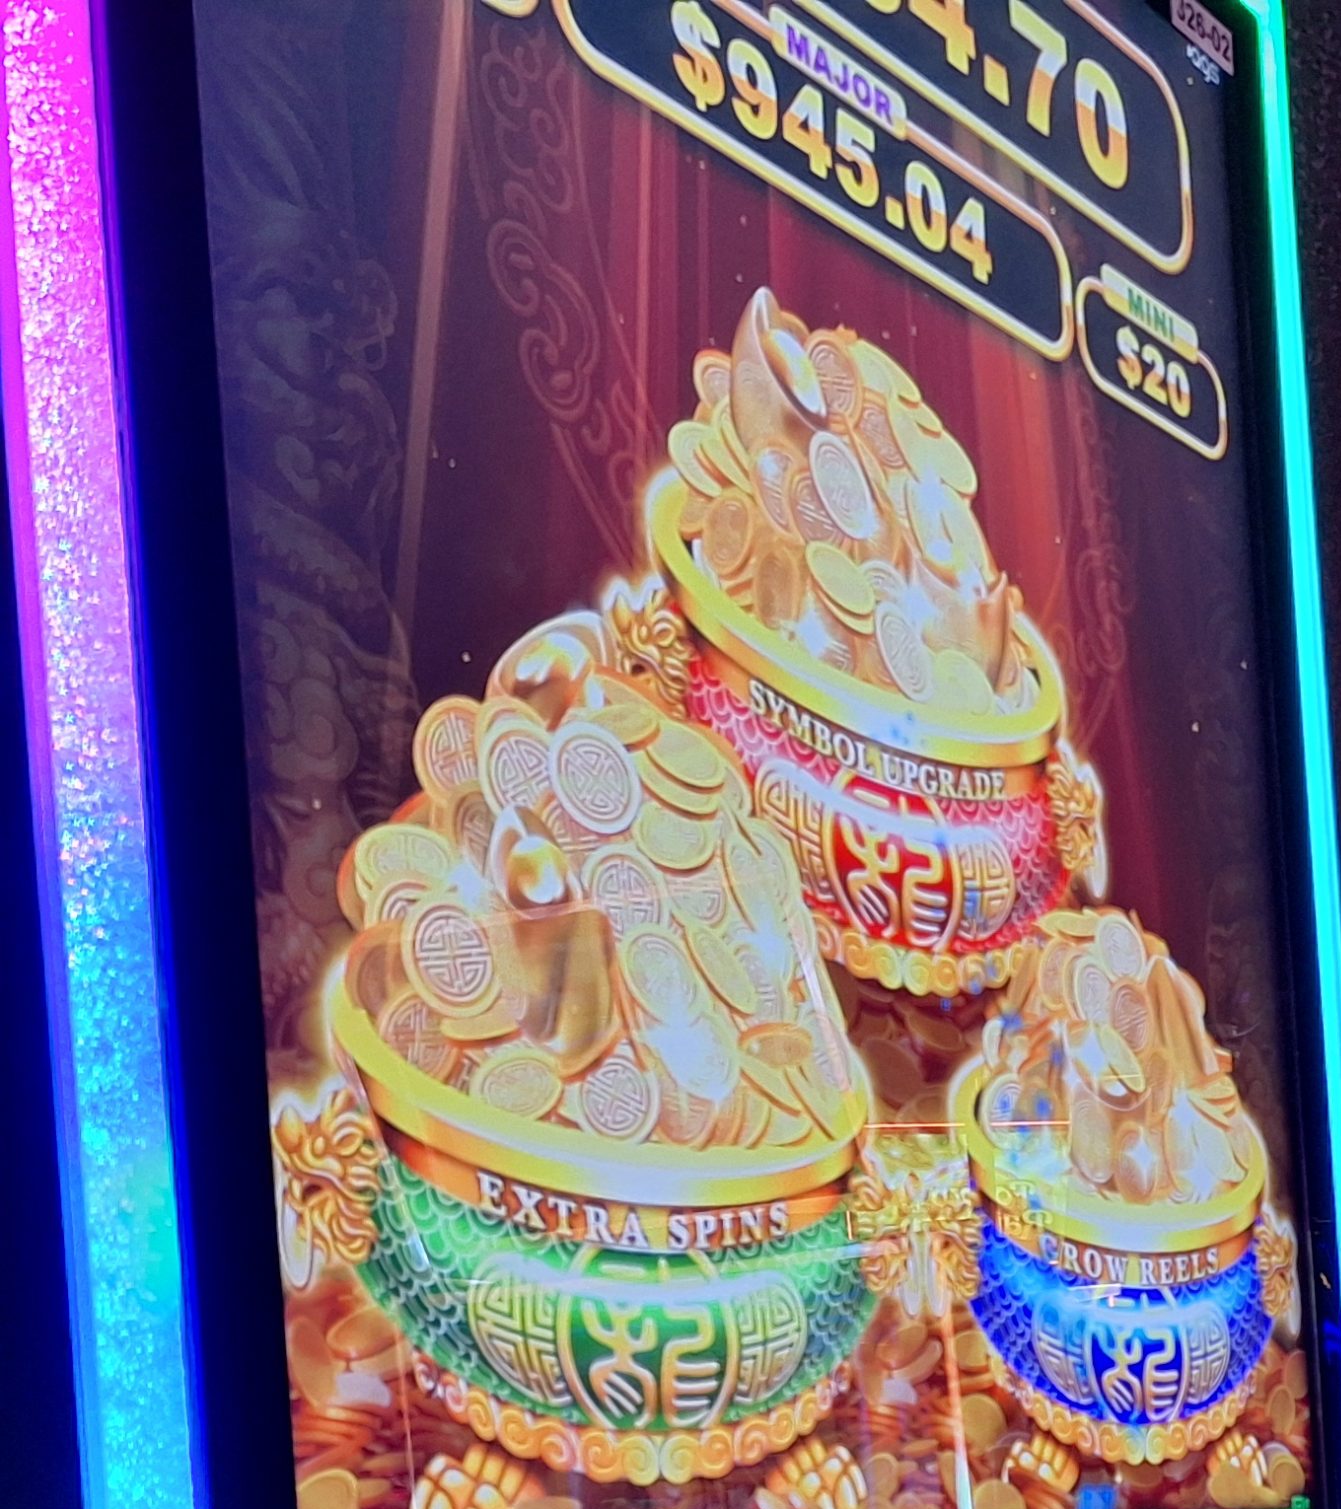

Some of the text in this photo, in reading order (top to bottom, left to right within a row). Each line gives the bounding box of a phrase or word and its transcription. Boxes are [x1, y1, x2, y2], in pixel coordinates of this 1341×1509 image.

[787, 25, 893, 126] MAJOR
[671, 0, 993, 285] $945.04
[1127, 287, 1176, 342] MINI
[1116, 326, 1192, 418] $20
[749, 680, 1006, 800] SYMBOL UPGRADE
[477, 1170, 789, 1249] EXTRA SPINS
[1040, 1231, 1219, 1288] GROW REELS
